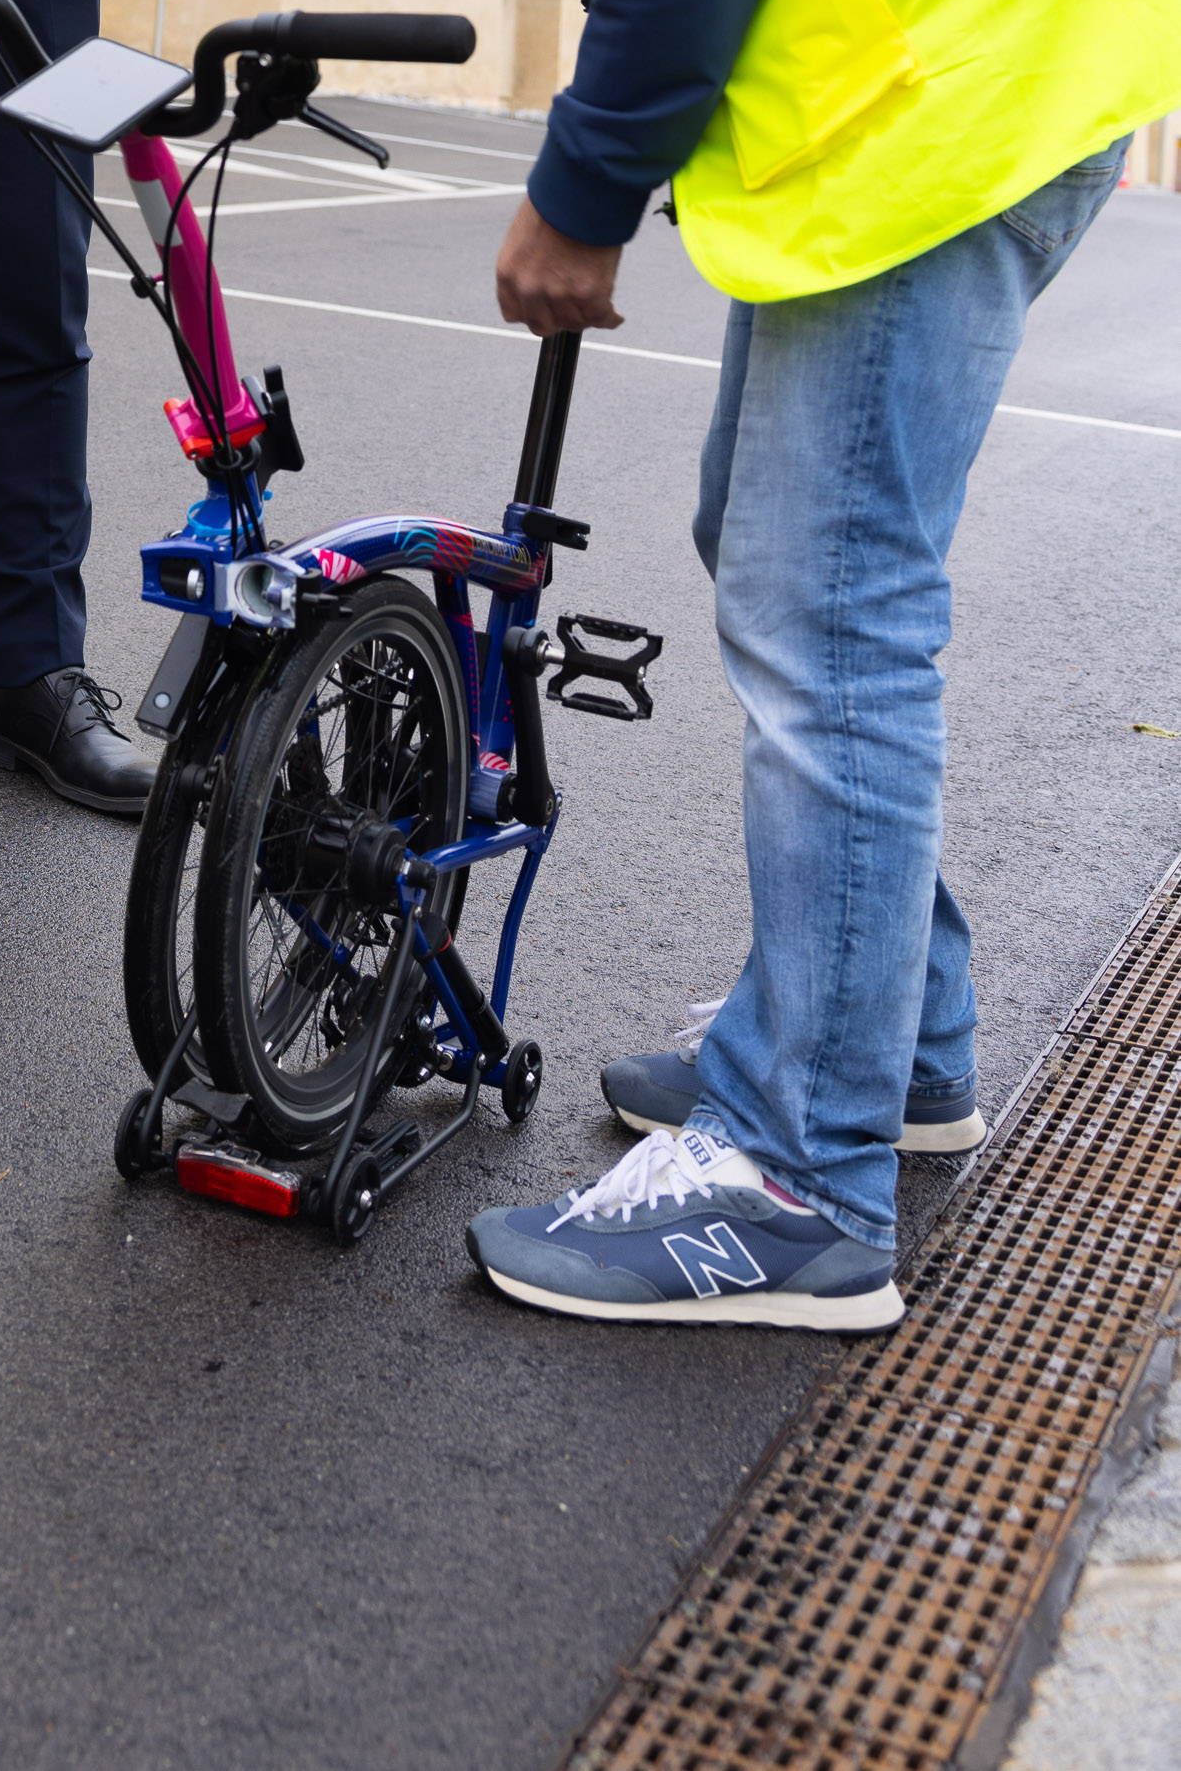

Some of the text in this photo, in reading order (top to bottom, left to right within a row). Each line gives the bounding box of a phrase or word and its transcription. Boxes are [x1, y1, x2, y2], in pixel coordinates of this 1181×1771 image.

[476, 538, 528, 565] BROMPTON
[685, 1135, 710, 1164] 515
[662, 1221, 767, 1299] N
